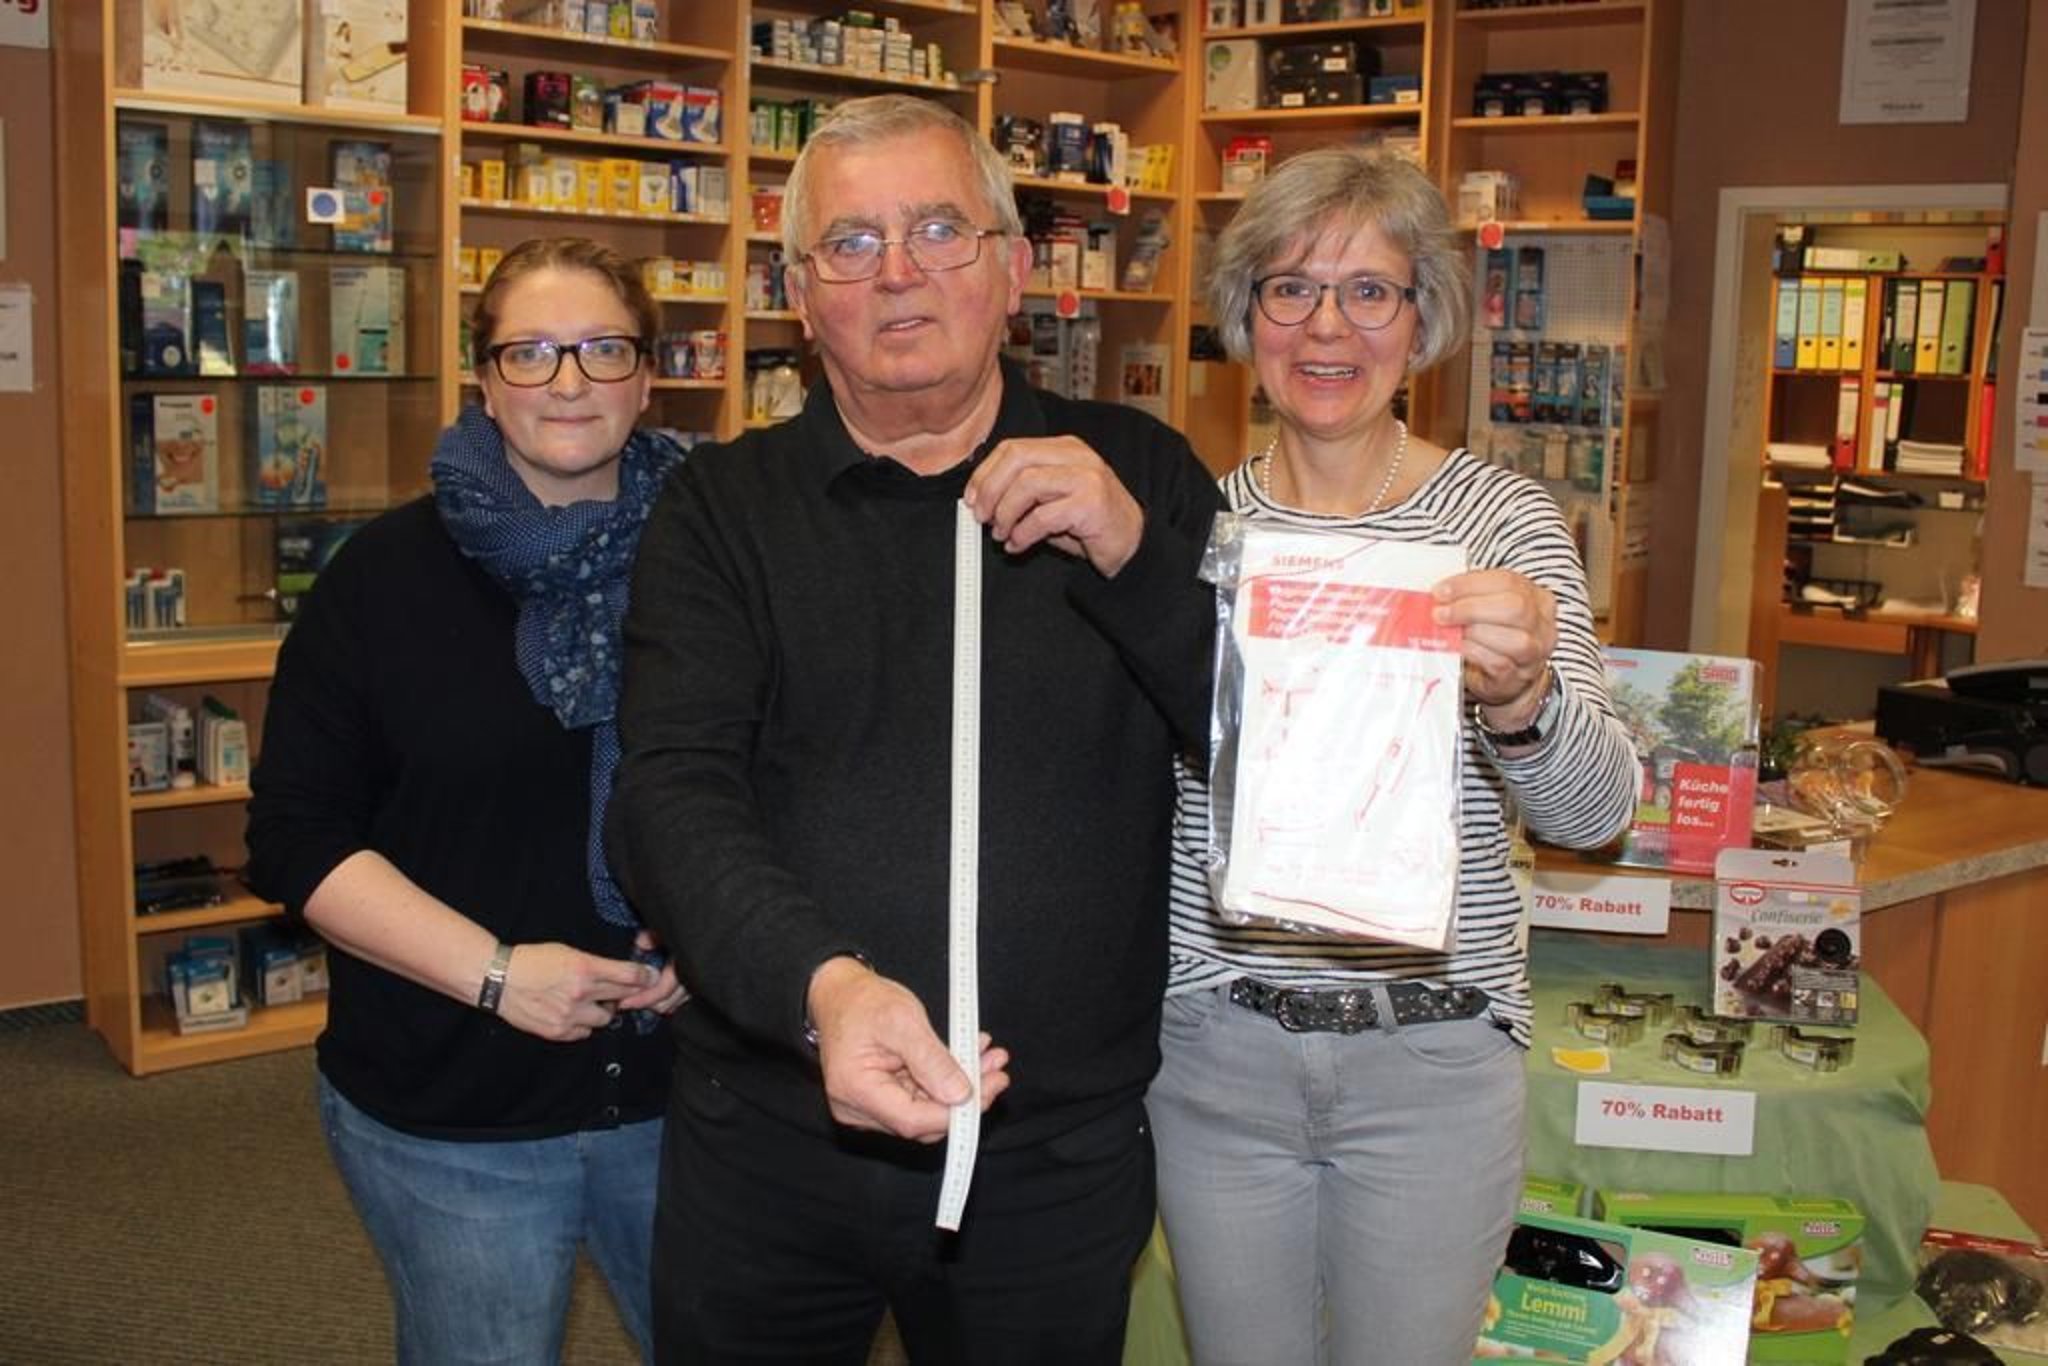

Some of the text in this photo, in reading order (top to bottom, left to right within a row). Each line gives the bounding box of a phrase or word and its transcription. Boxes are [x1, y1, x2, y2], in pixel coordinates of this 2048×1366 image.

[1678, 795, 1720, 812] fertig
[1535, 895, 1642, 916] 70% Rabatt
[1751, 910, 1822, 925] Confiserie
[1601, 1100, 1723, 1123] 70% Rabatt
[1521, 1291, 1585, 1322] Lemmi
